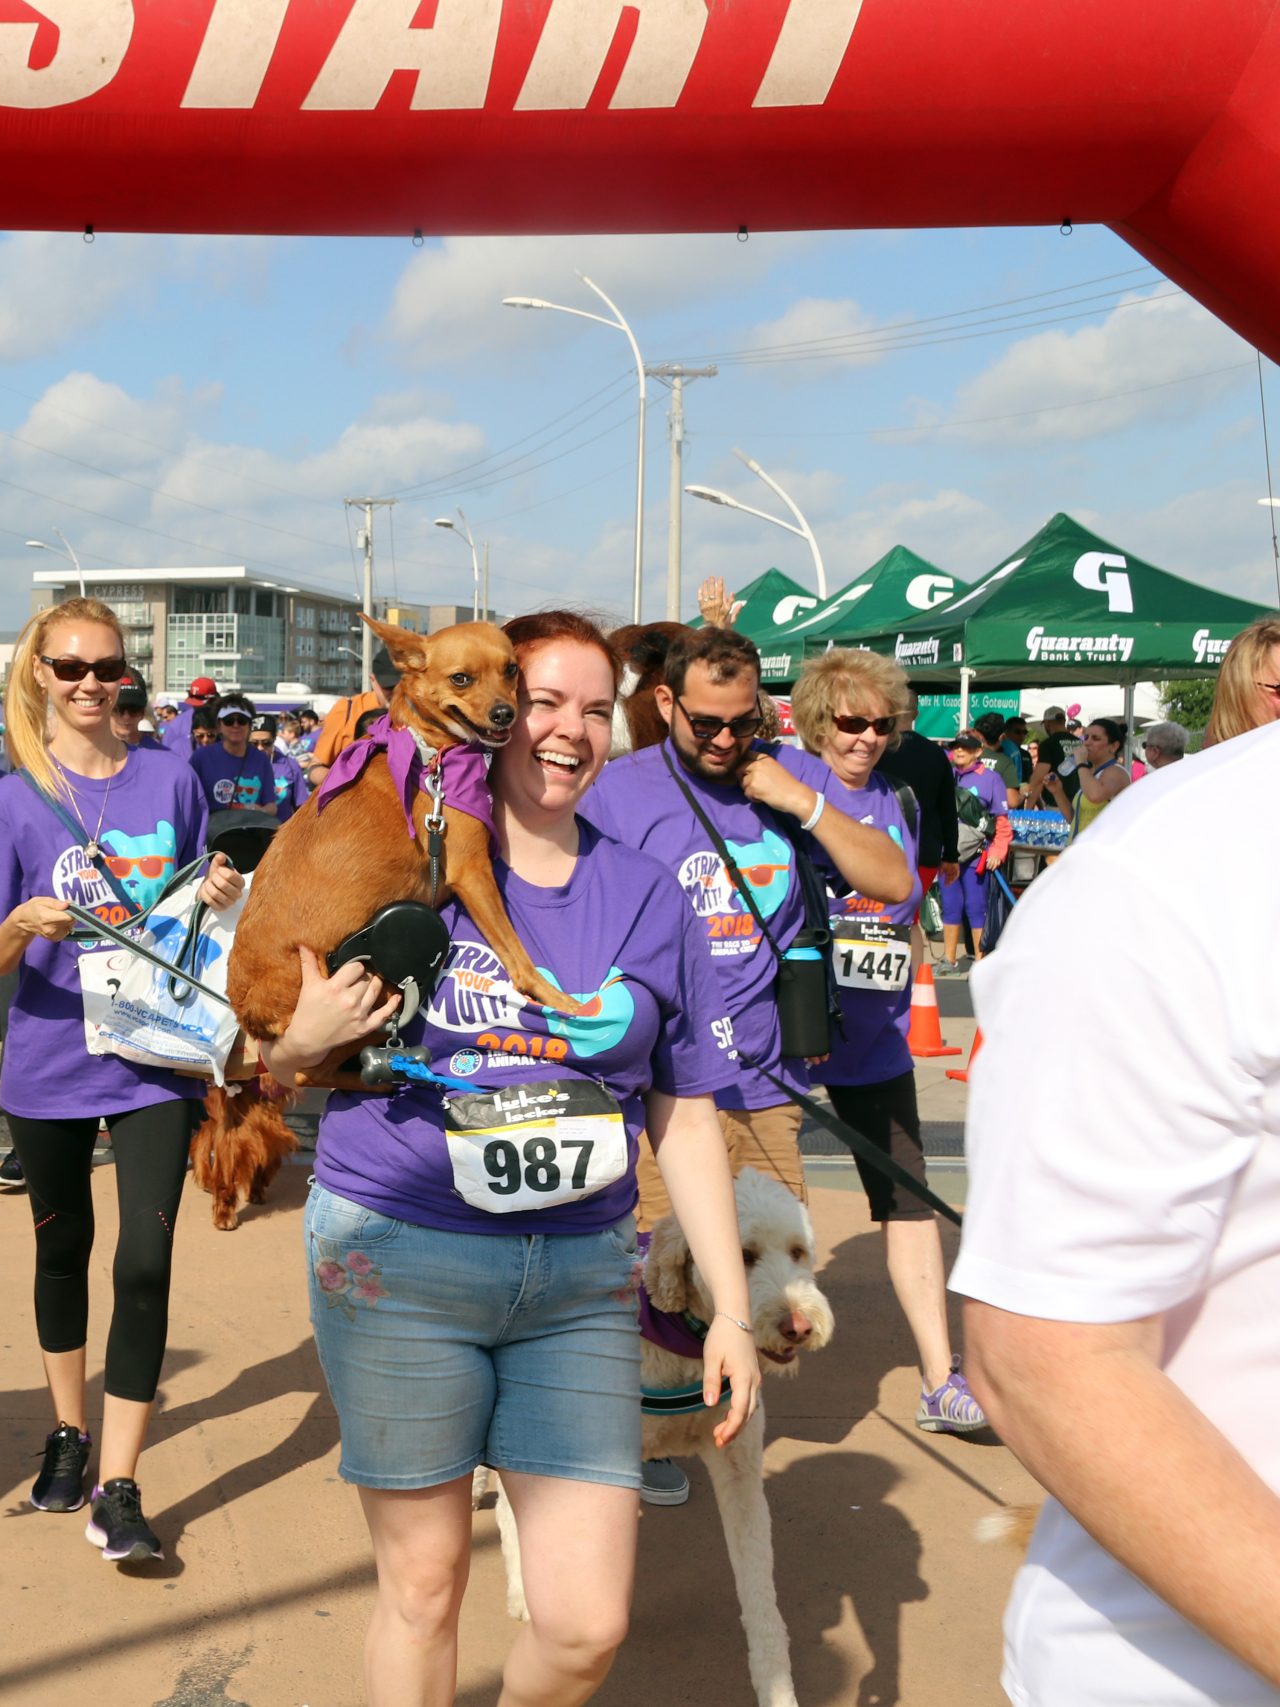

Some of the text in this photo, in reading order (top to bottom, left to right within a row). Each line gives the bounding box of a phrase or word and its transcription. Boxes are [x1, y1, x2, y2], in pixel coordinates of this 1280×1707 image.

[895, 633, 939, 664] Guaranty
[1026, 626, 1134, 662] Guaranty
[1041, 652, 1117, 662] Bank & Trust
[983, 695, 1018, 710] Gateway
[707, 914, 754, 937] 2018
[840, 949, 907, 981] 1447
[454, 970, 495, 993] YOUR
[493, 1089, 570, 1112] luke's
[483, 1137, 595, 1195] 987
